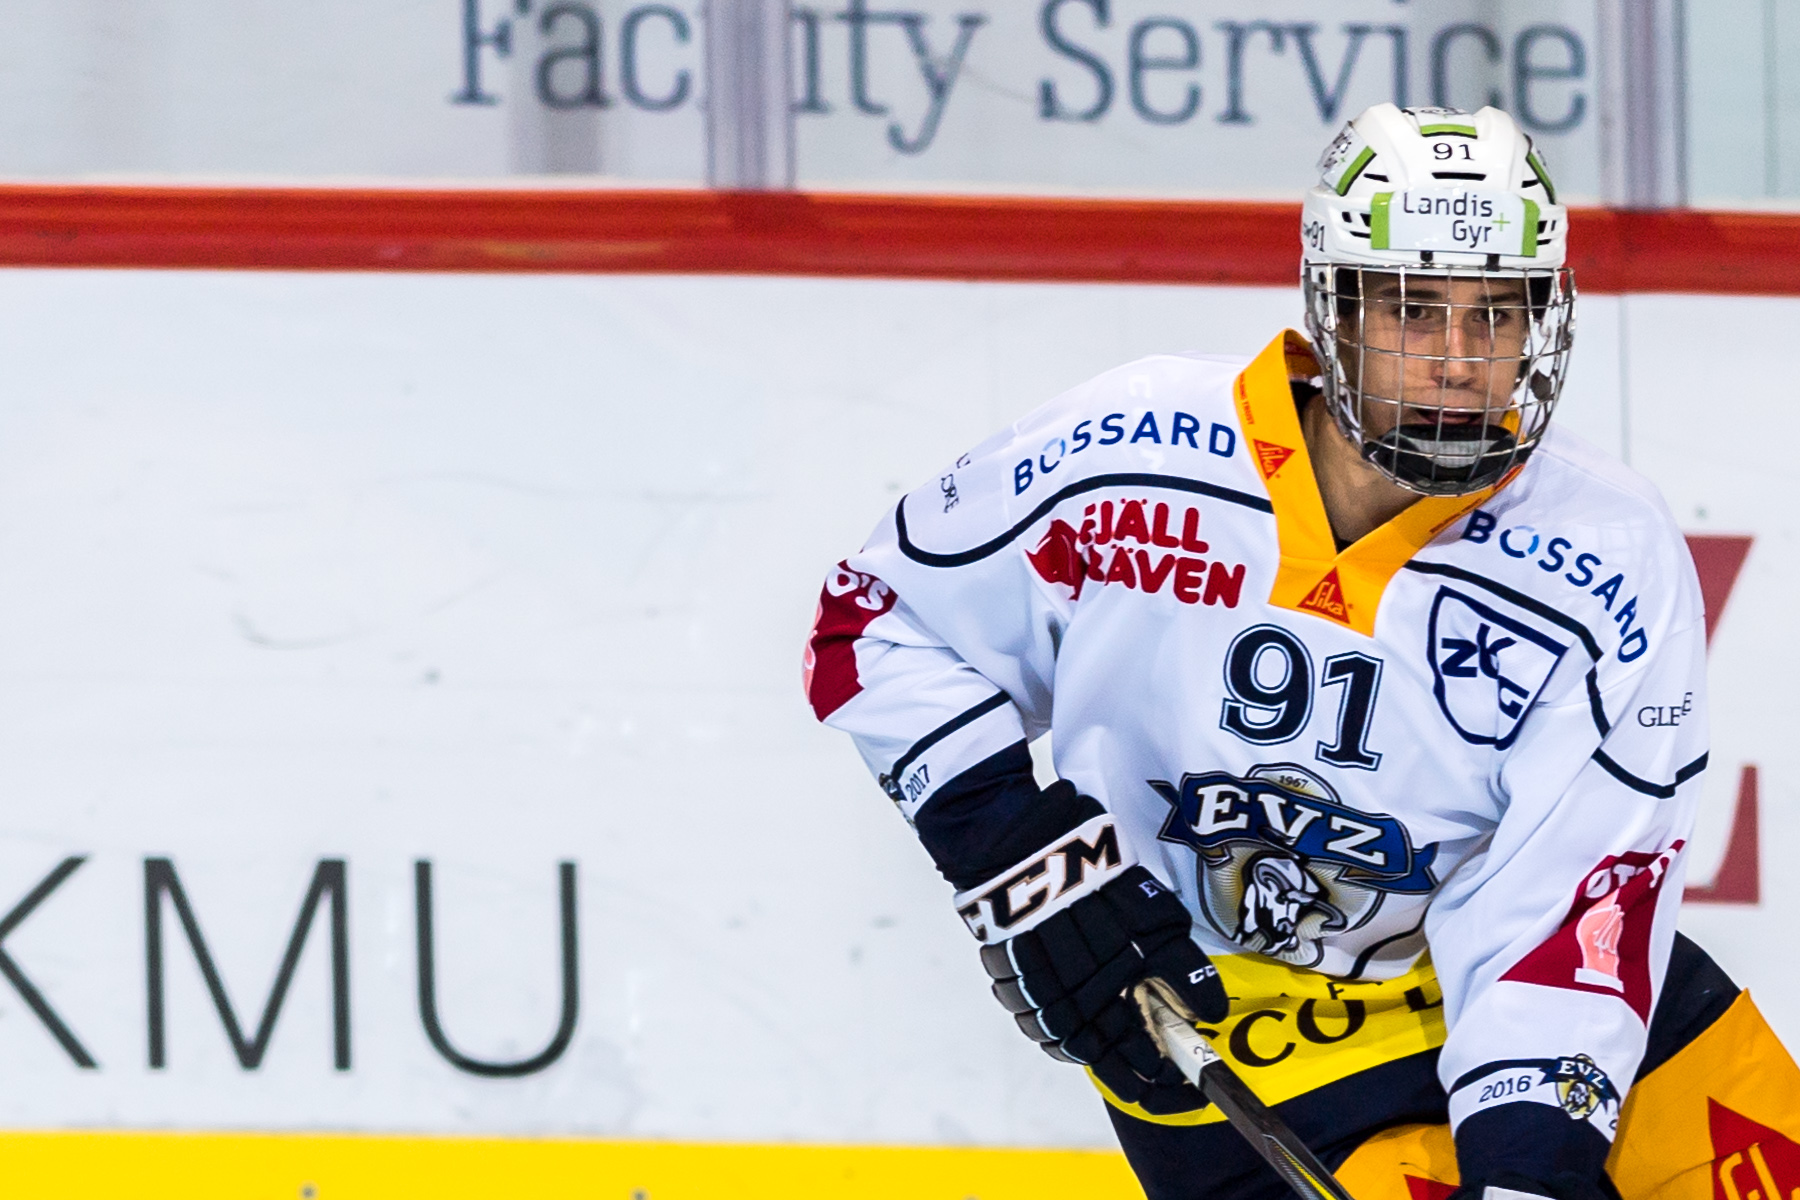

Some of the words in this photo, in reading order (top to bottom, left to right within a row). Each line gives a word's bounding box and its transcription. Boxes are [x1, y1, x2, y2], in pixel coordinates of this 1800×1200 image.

[449, 0, 987, 154] Facity
[1432, 142, 1475, 161] 91
[1403, 192, 1493, 218] Landis
[1014, 411, 1237, 497] BOSSARD
[1305, 581, 1344, 615] Sika
[1461, 508, 1648, 664] BOSSARD
[1219, 624, 1384, 772] 91
[905, 763, 930, 803] 2017
[1278, 774, 1308, 790] 1967
[1190, 783, 1386, 866] EVZ
[1478, 1075, 1532, 1104] 2016
[1558, 1060, 1605, 1089] EVZ
